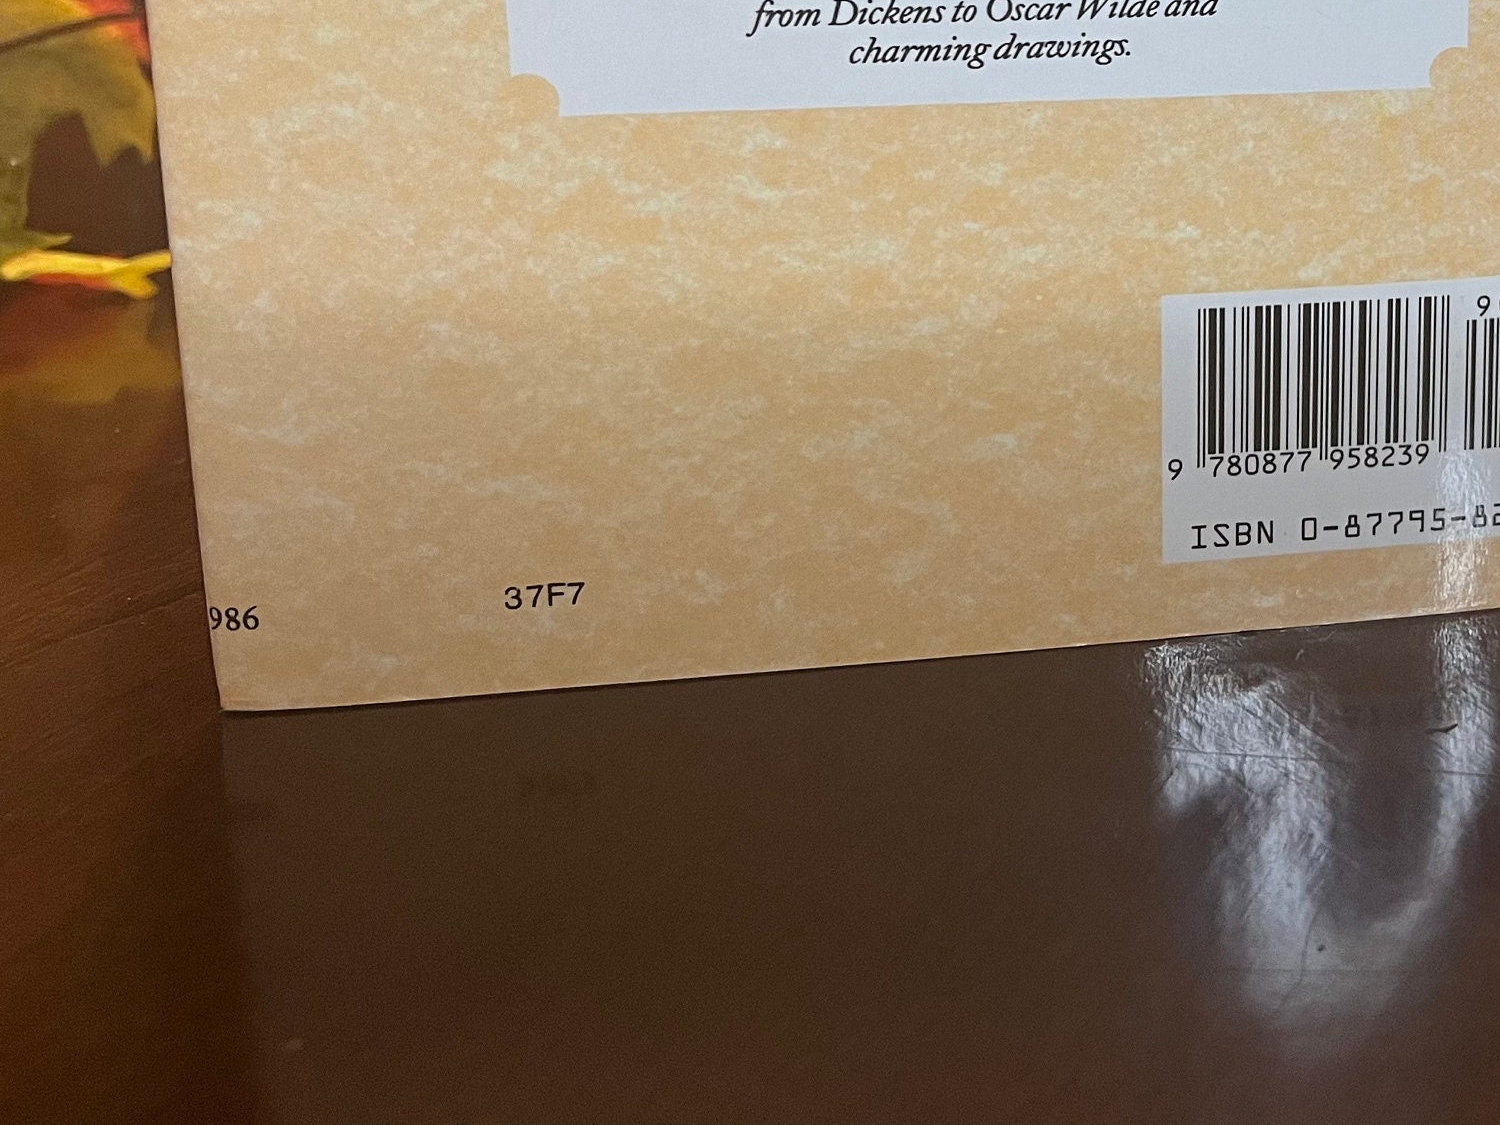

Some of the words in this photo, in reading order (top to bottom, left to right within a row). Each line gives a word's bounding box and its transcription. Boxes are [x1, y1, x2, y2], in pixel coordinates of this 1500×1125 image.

[746, 0, 821, 37] from
[951, 1, 977, 22] to
[849, 36, 992, 69] charming
[993, 32, 1130, 65] drawings.
[1167, 458, 1184, 481] 9
[1209, 450, 1313, 478] 780877
[1329, 443, 1431, 470] 958239
[1191, 520, 1276, 551] ISBN
[503, 581, 586, 610] 37F7
[209, 605, 260, 632] 986
